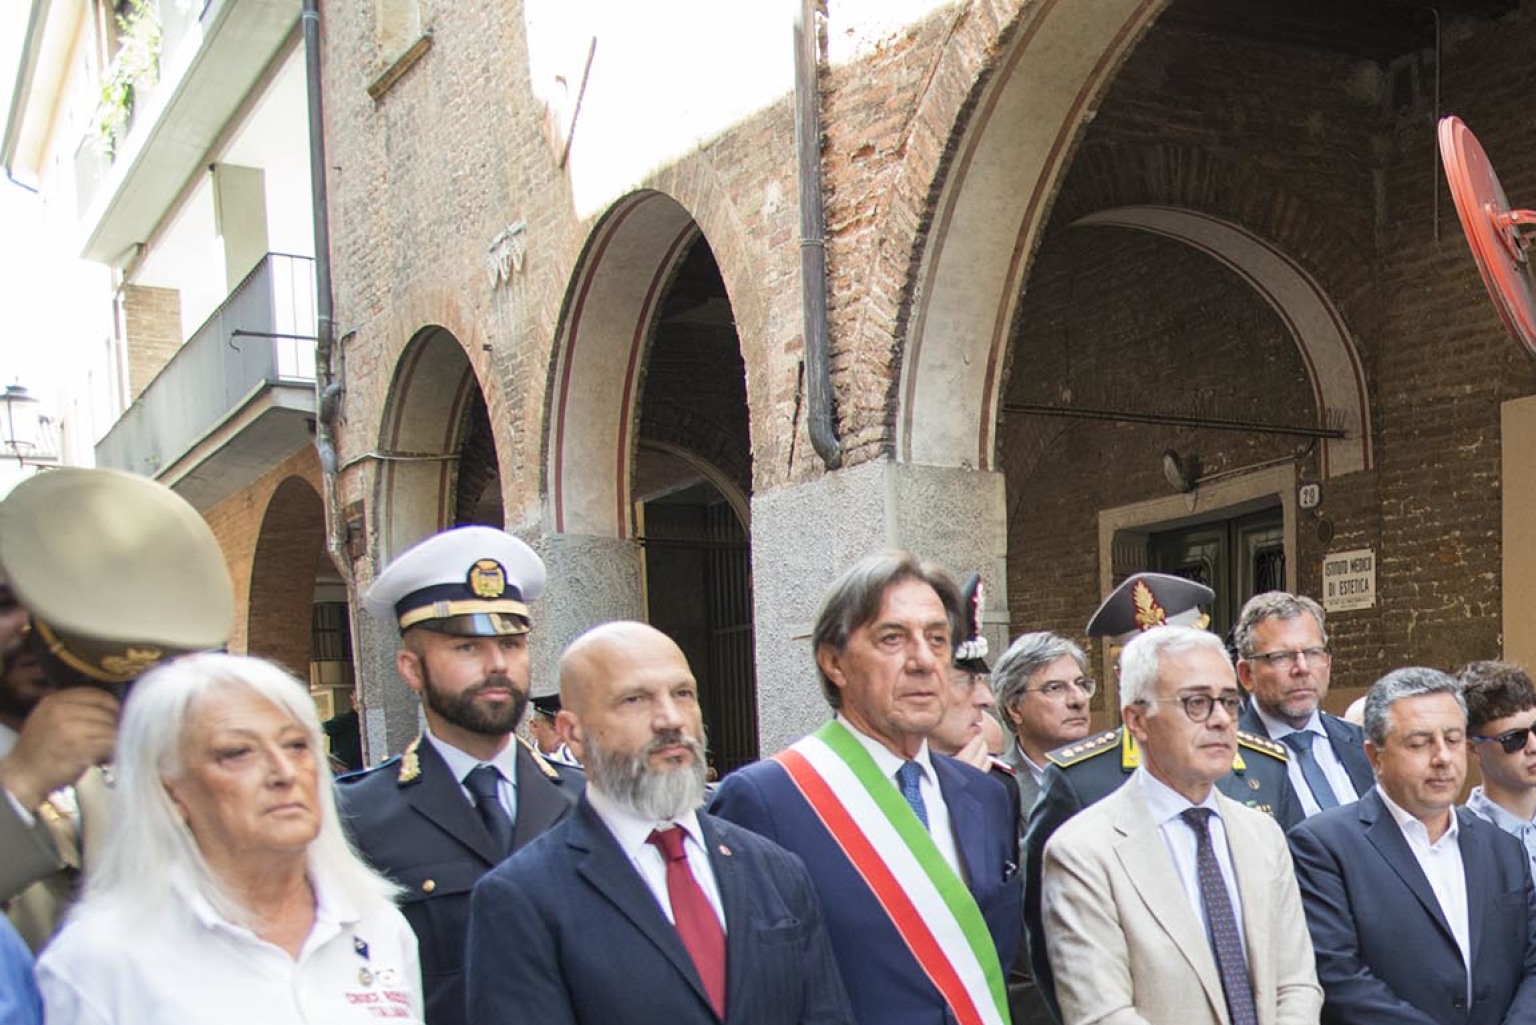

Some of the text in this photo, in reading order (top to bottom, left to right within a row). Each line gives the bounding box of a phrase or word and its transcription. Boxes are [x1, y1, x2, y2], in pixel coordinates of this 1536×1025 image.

[1303, 488, 1315, 505] 29
[1350, 556, 1371, 573] MEDICO
[1328, 578, 1369, 597] DI ESTETICA
